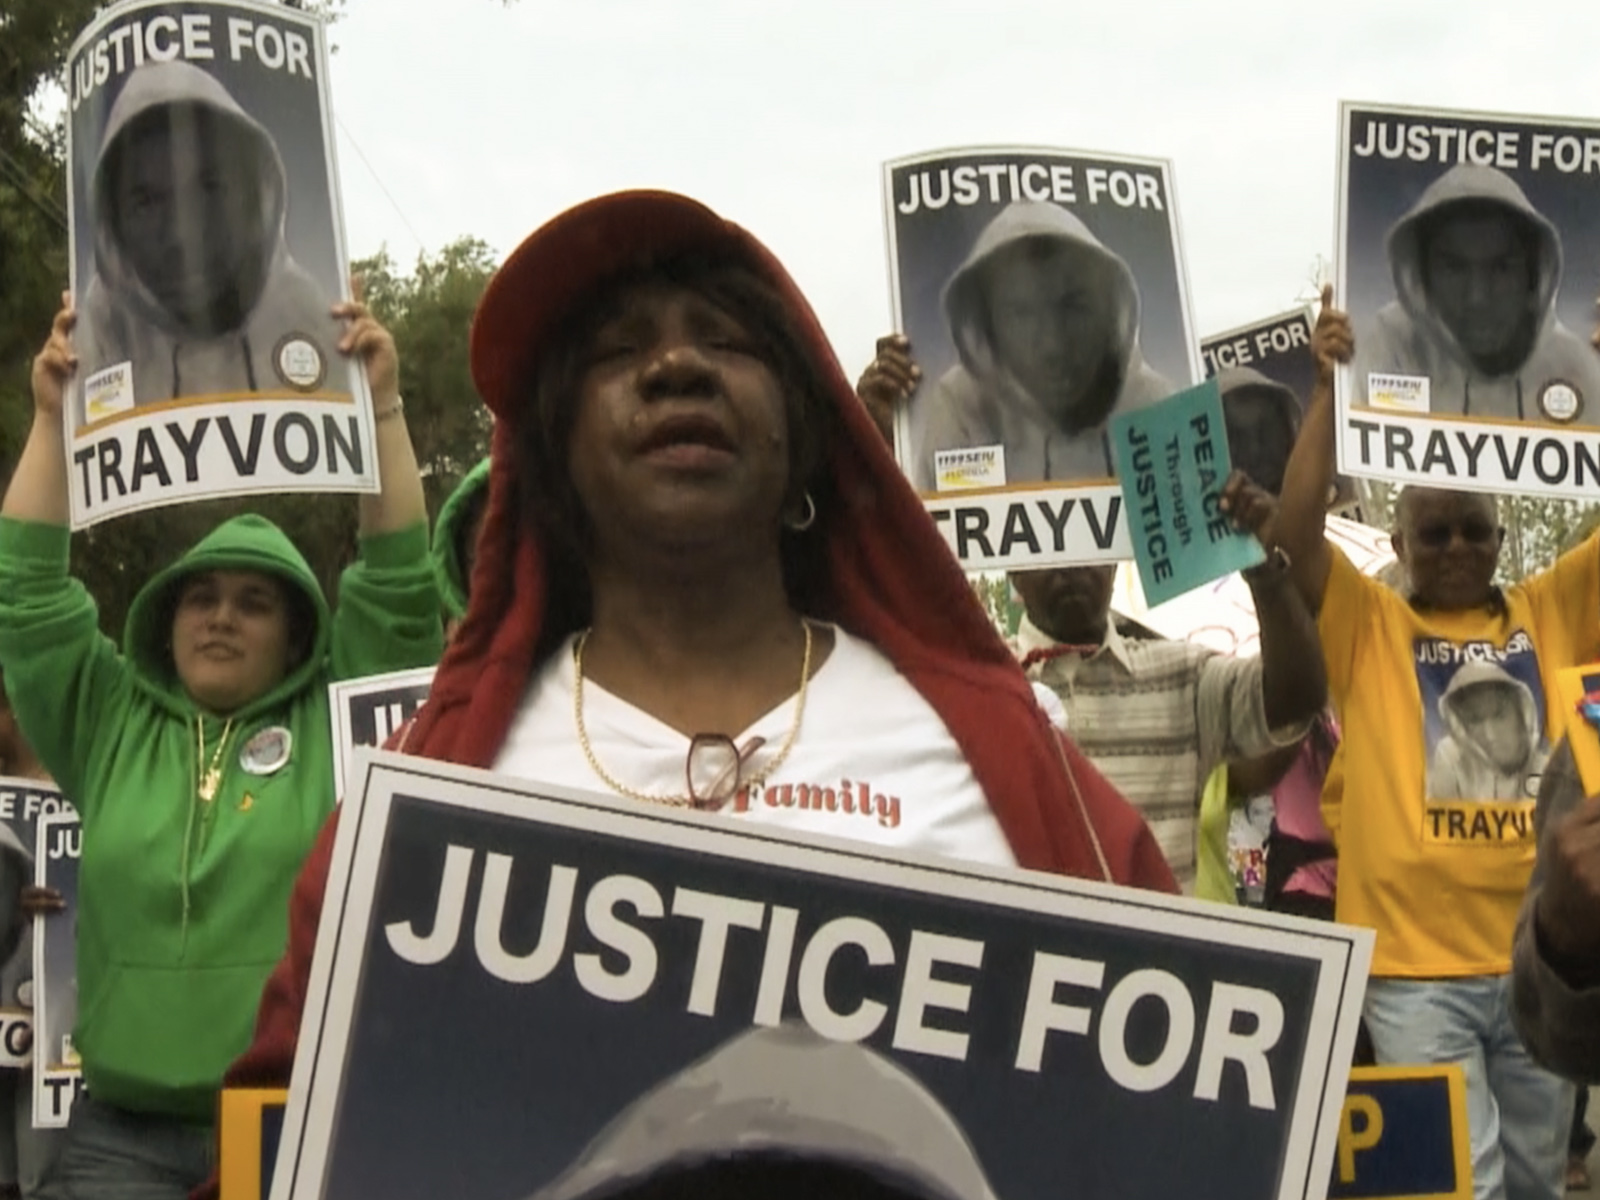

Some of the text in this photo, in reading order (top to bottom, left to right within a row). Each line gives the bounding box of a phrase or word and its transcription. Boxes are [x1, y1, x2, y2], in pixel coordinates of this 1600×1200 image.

[71, 15, 312, 110] JUSTICE FOR
[899, 163, 1164, 215] JUSTICE FOR
[1354, 121, 1519, 168] JUSTICE
[1255, 322, 1310, 359] FOR
[74, 411, 364, 509] TRAYVON
[1128, 425, 1173, 584] JUSTICE
[1165, 434, 1193, 547] Through
[1190, 413, 1231, 543] PEACE
[733, 778, 901, 829] Family
[384, 843, 1285, 1112] JUSTICE FOR
